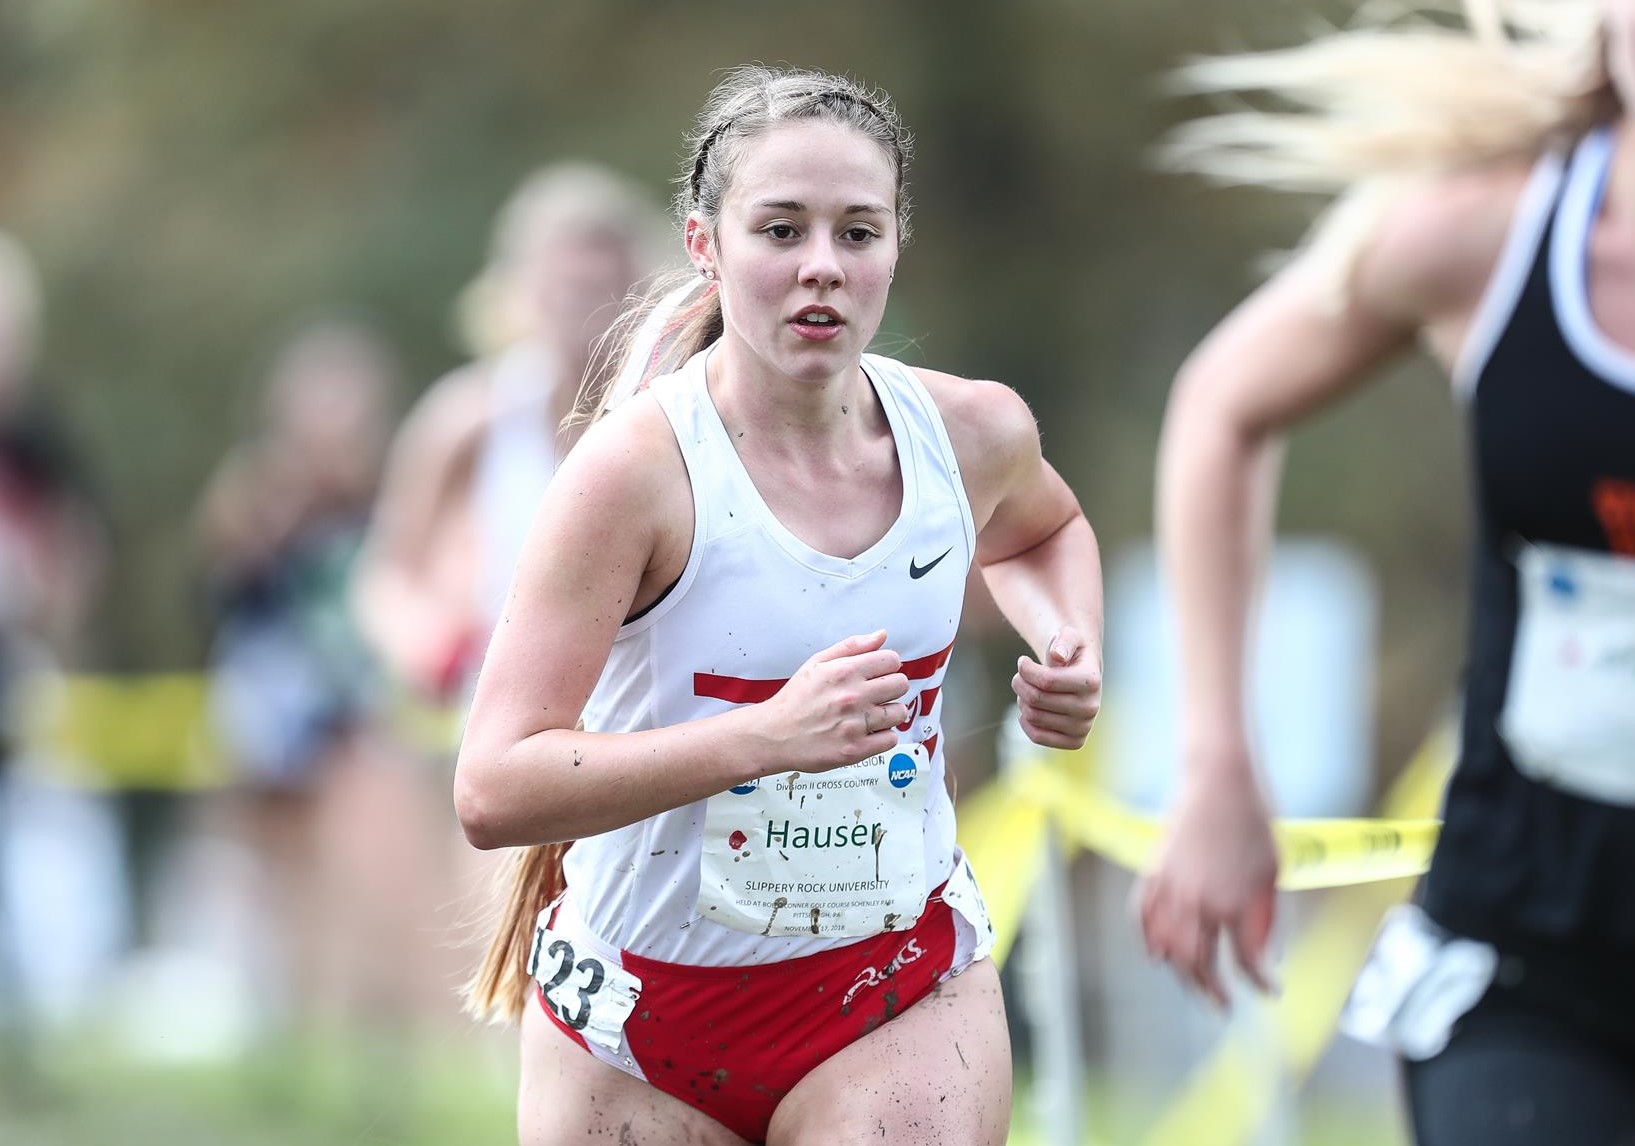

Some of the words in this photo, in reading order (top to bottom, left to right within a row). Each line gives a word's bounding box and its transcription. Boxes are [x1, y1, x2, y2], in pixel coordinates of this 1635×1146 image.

[891, 768, 917, 781] NCAA
[776, 782, 807, 791] Division
[816, 780, 842, 790] CROSS
[843, 778, 879, 789] COUNTRY
[766, 819, 882, 849] Hauser
[745, 880, 794, 893] SLIPPERY
[797, 883, 826, 893] ROCK
[829, 879, 889, 893] UNIVERISITY
